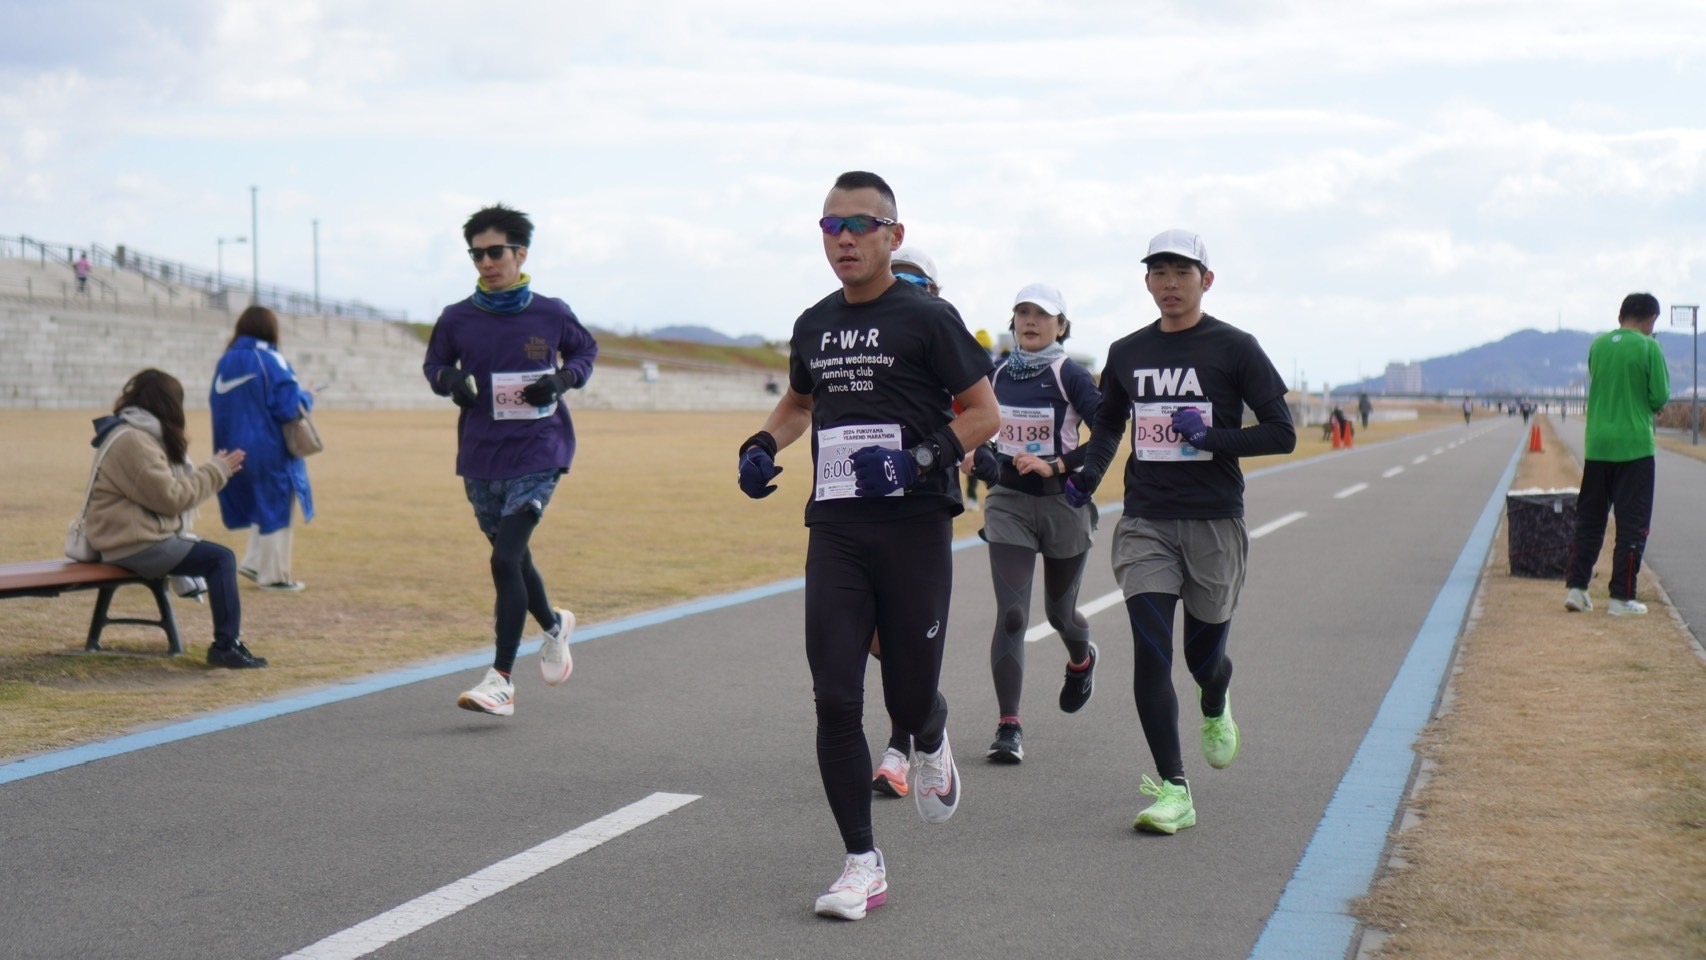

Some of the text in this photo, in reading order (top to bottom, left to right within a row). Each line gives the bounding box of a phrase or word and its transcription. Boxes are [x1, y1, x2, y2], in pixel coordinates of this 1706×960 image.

[810, 353, 895, 370] fukuyama wednesday
[822, 366, 874, 380] running club
[828, 380, 874, 393] since 2020
[1133, 368, 1204, 397] TWA
[1137, 424, 1186, 443] D-30
[823, 459, 854, 480] 6:00
